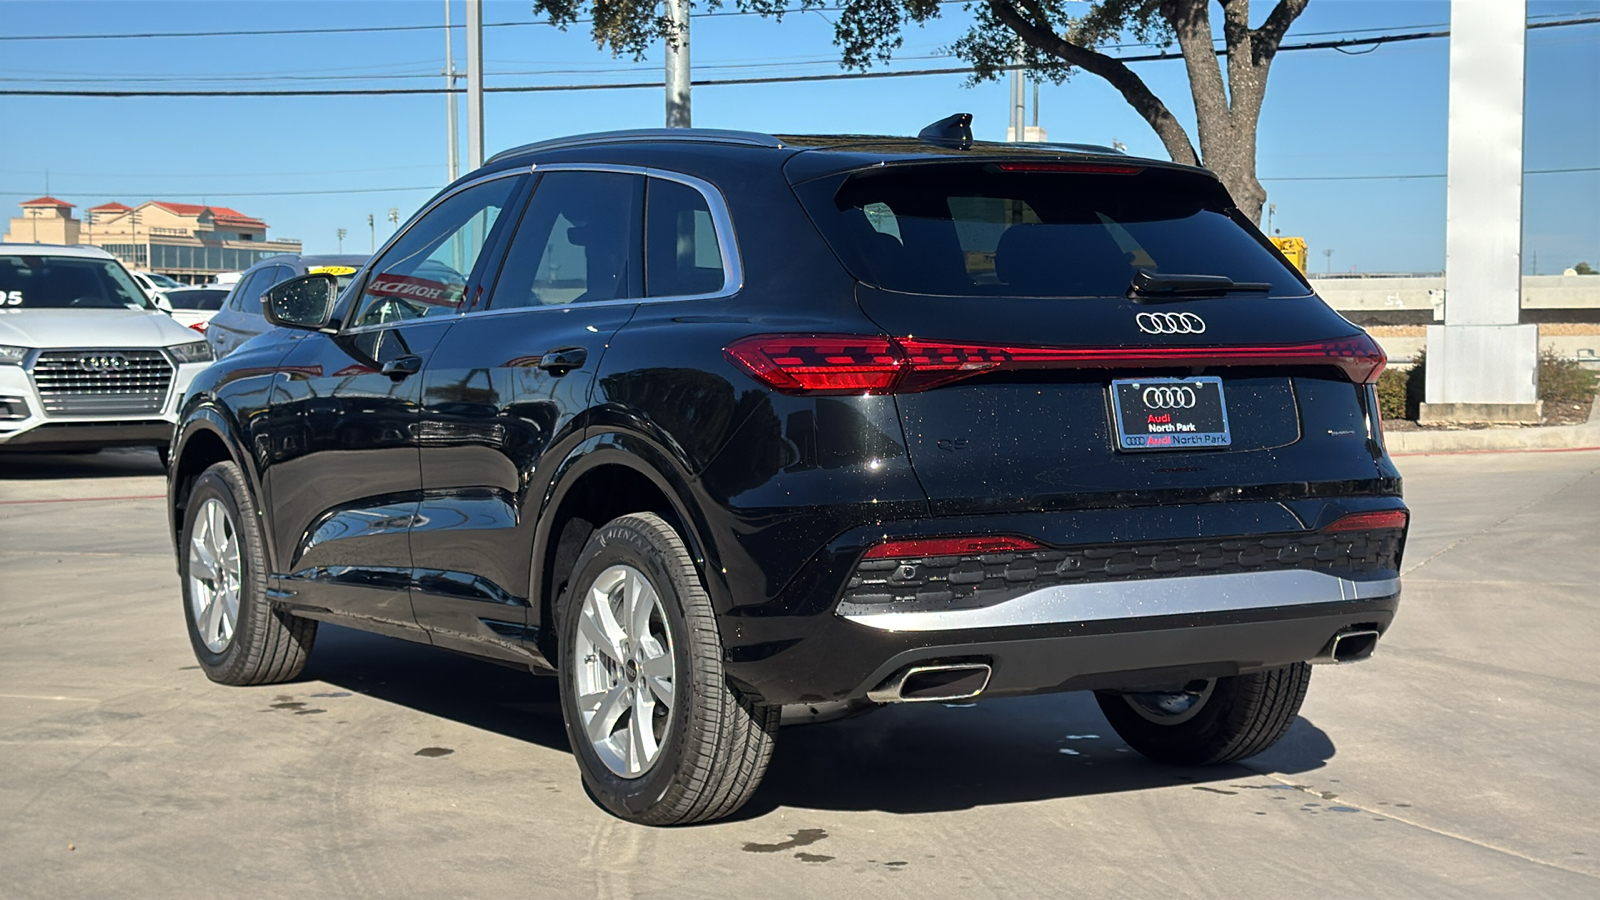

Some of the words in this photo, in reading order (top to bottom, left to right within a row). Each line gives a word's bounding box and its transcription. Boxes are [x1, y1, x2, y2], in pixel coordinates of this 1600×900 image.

[1147, 414, 1171, 423] Audi
[1149, 424, 1175, 432] North
[1176, 423, 1196, 432] Park
[1147, 436, 1172, 445] Audi
[1173, 435, 1202, 444] North
[1204, 435, 1226, 444] Park
[938, 439, 967, 452] Q5
